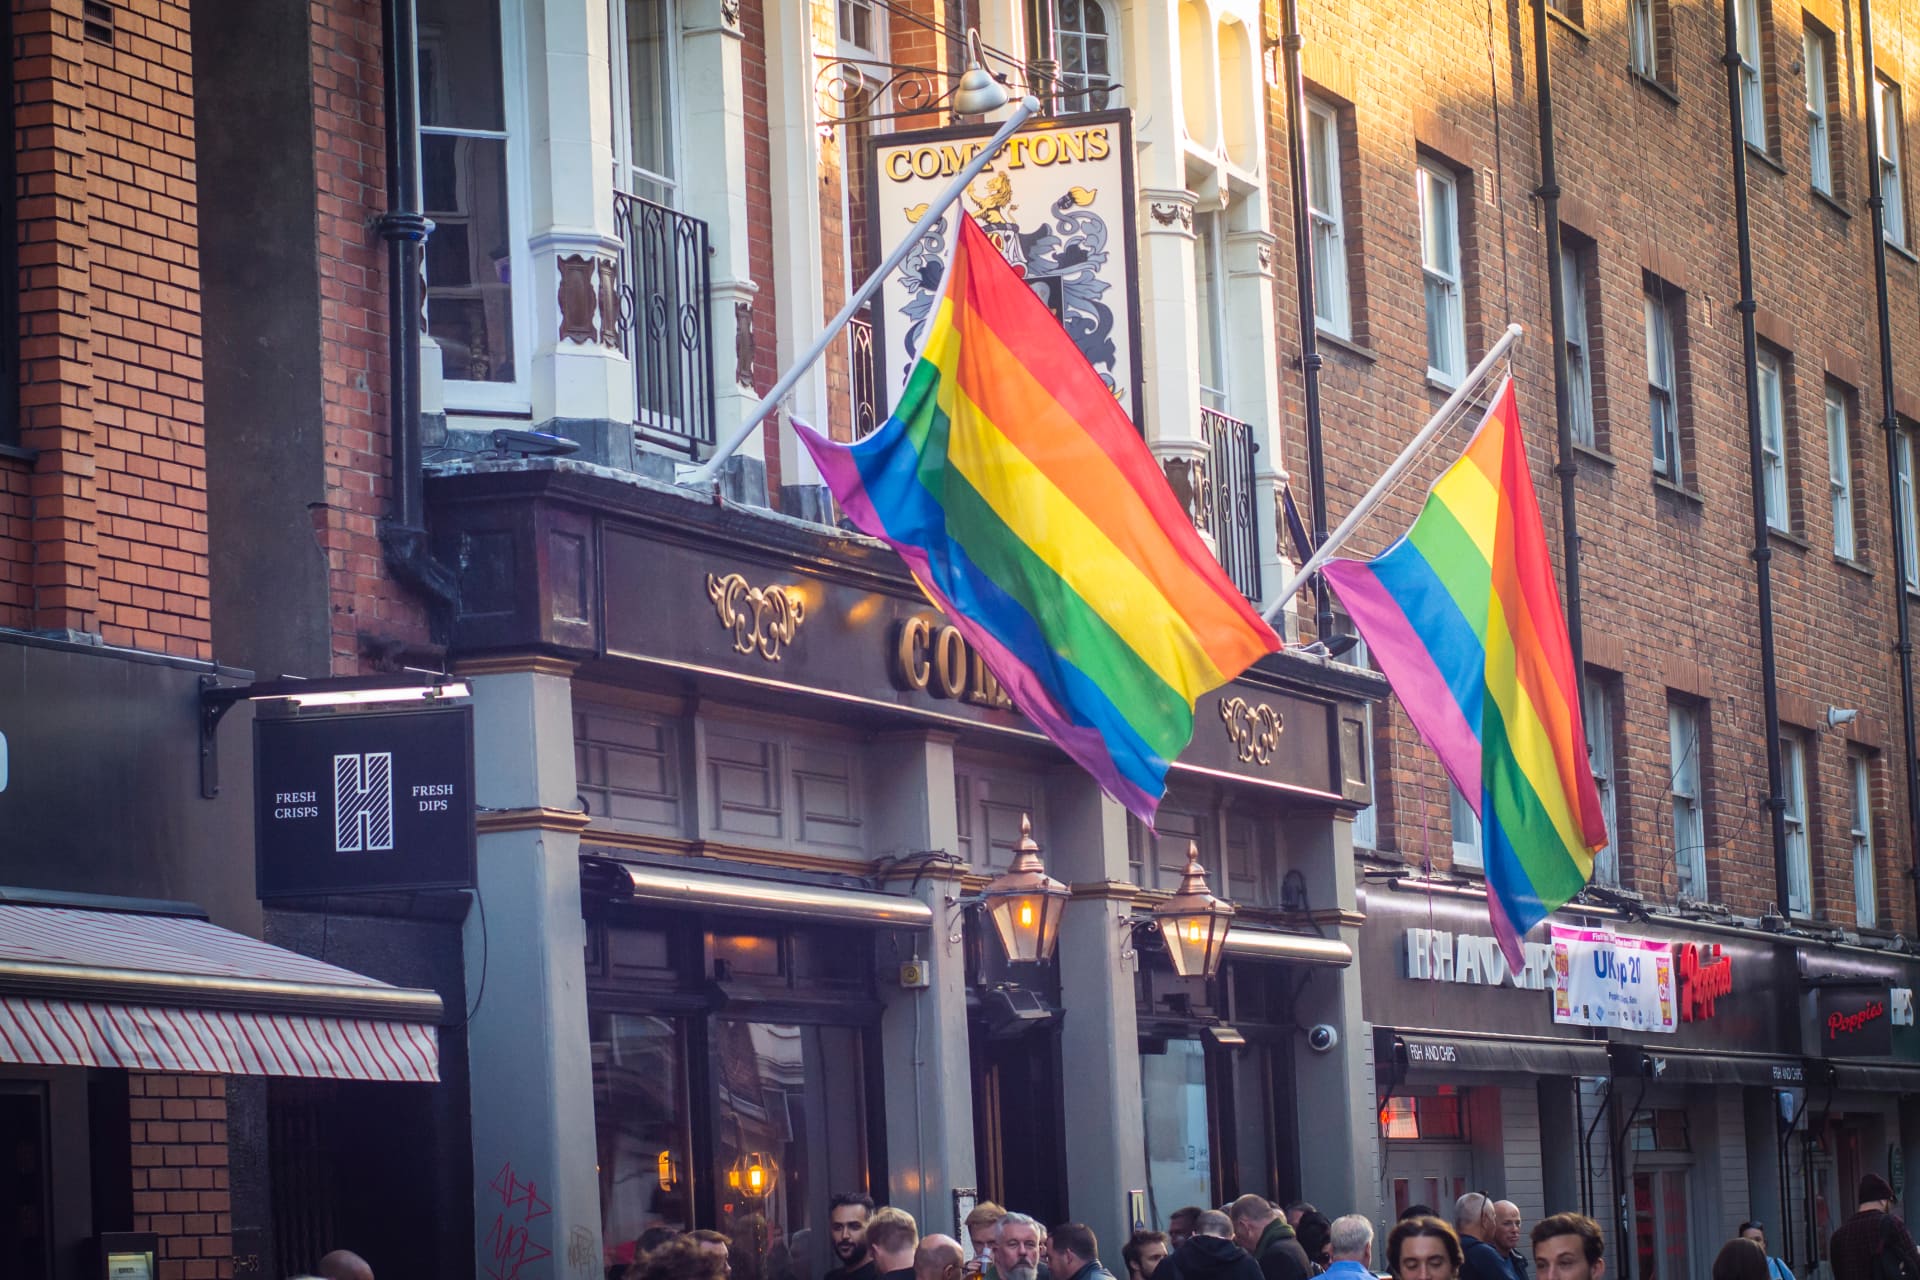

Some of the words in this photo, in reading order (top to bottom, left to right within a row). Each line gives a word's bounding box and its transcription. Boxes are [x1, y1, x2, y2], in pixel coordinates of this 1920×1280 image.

[275, 791, 317, 804] FRESH
[412, 784, 454, 797] FRESH
[274, 806, 318, 819] CRISPS
[418, 799, 448, 812] DIPS
[1406, 928, 1454, 981] FISH
[1456, 934, 1504, 985] AND
[1511, 942, 1558, 991] HIPS
[1680, 942, 1732, 1023] Poppies
[1828, 1001, 1883, 1039] Poppies
[1410, 1044, 1424, 1060] FISH
[1425, 1045, 1439, 1061] AND
[1440, 1046, 1455, 1062] CHIPS
